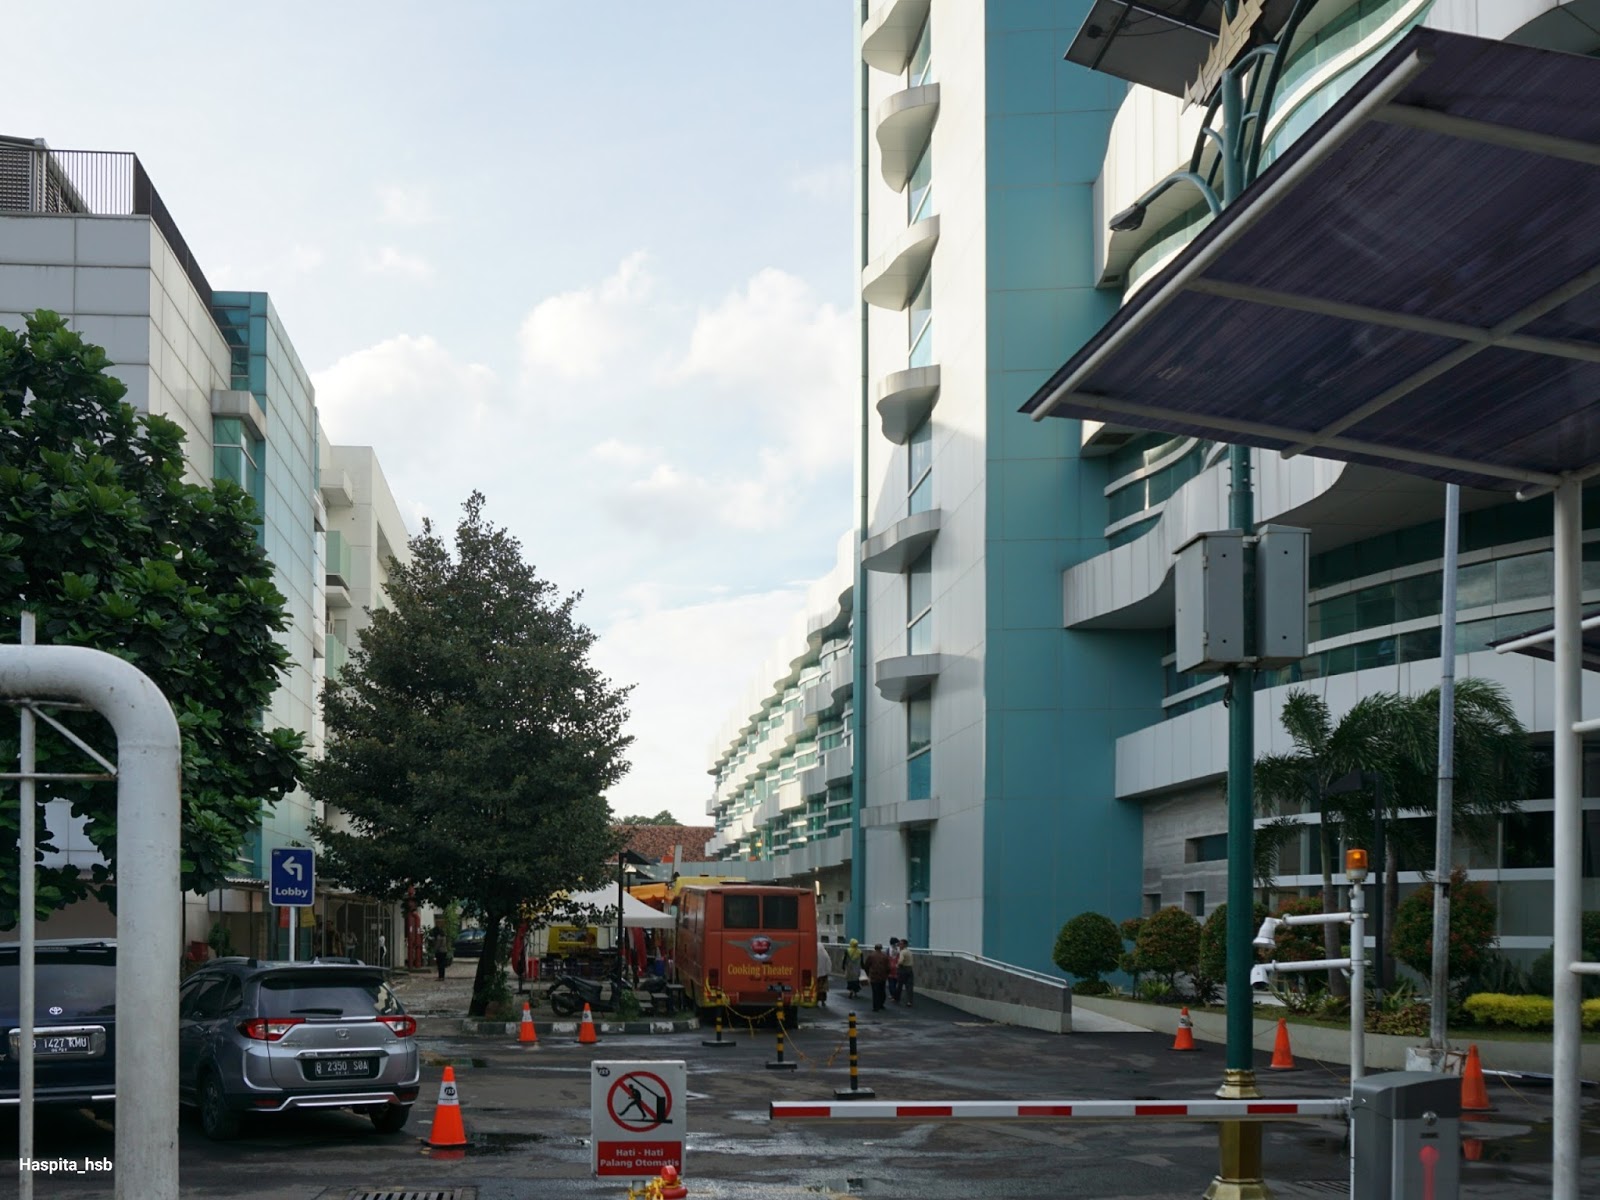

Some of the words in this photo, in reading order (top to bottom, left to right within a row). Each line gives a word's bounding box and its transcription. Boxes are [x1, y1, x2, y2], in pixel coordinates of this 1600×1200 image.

[275, 887, 308, 898] Lobby
[727, 964, 760, 977] Cooking
[761, 964, 793, 976] Theater
[44, 1038, 64, 1048] 1427
[327, 1061, 347, 1071] 2350
[615, 1148, 636, 1157] Hati
[644, 1148, 664, 1157] Hati
[600, 1159, 633, 1168] Palang
[635, 1159, 680, 1167] Otomatis
